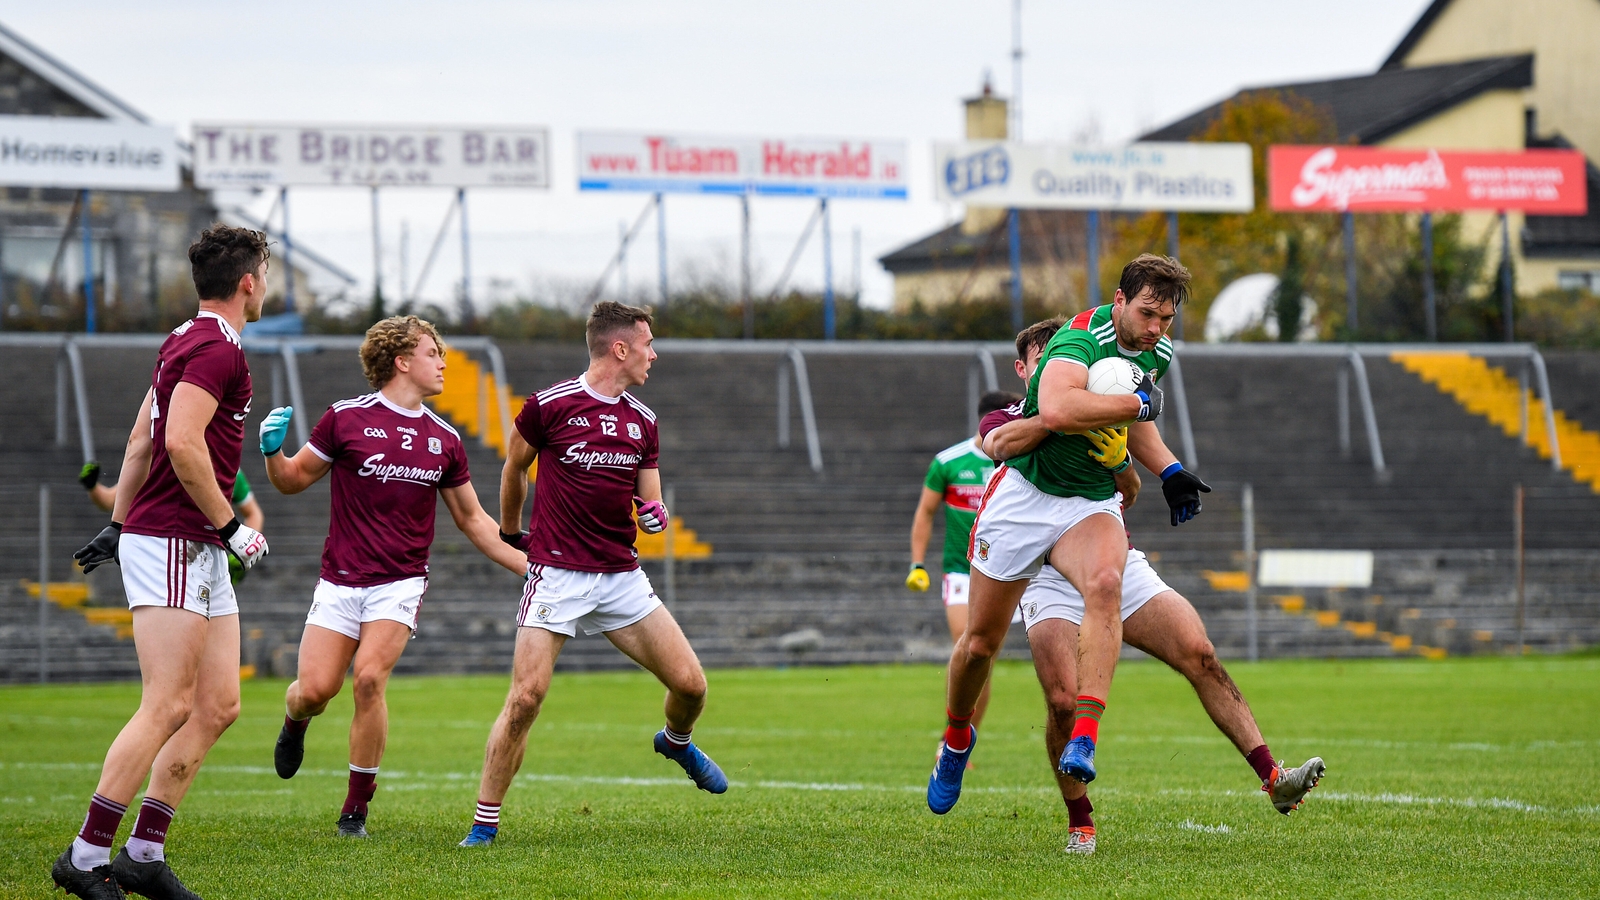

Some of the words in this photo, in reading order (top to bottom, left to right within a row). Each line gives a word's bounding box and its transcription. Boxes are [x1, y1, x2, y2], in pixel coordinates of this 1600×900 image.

[1, 139, 163, 166] Homevalue
[201, 130, 279, 164] THE
[300, 131, 442, 165] BRIDGE
[461, 133, 539, 165] BAR
[1032, 168, 1125, 205] Quality
[1136, 171, 1236, 199] Plastics
[401, 434, 413, 451] 2
[600, 421, 618, 437] 12
